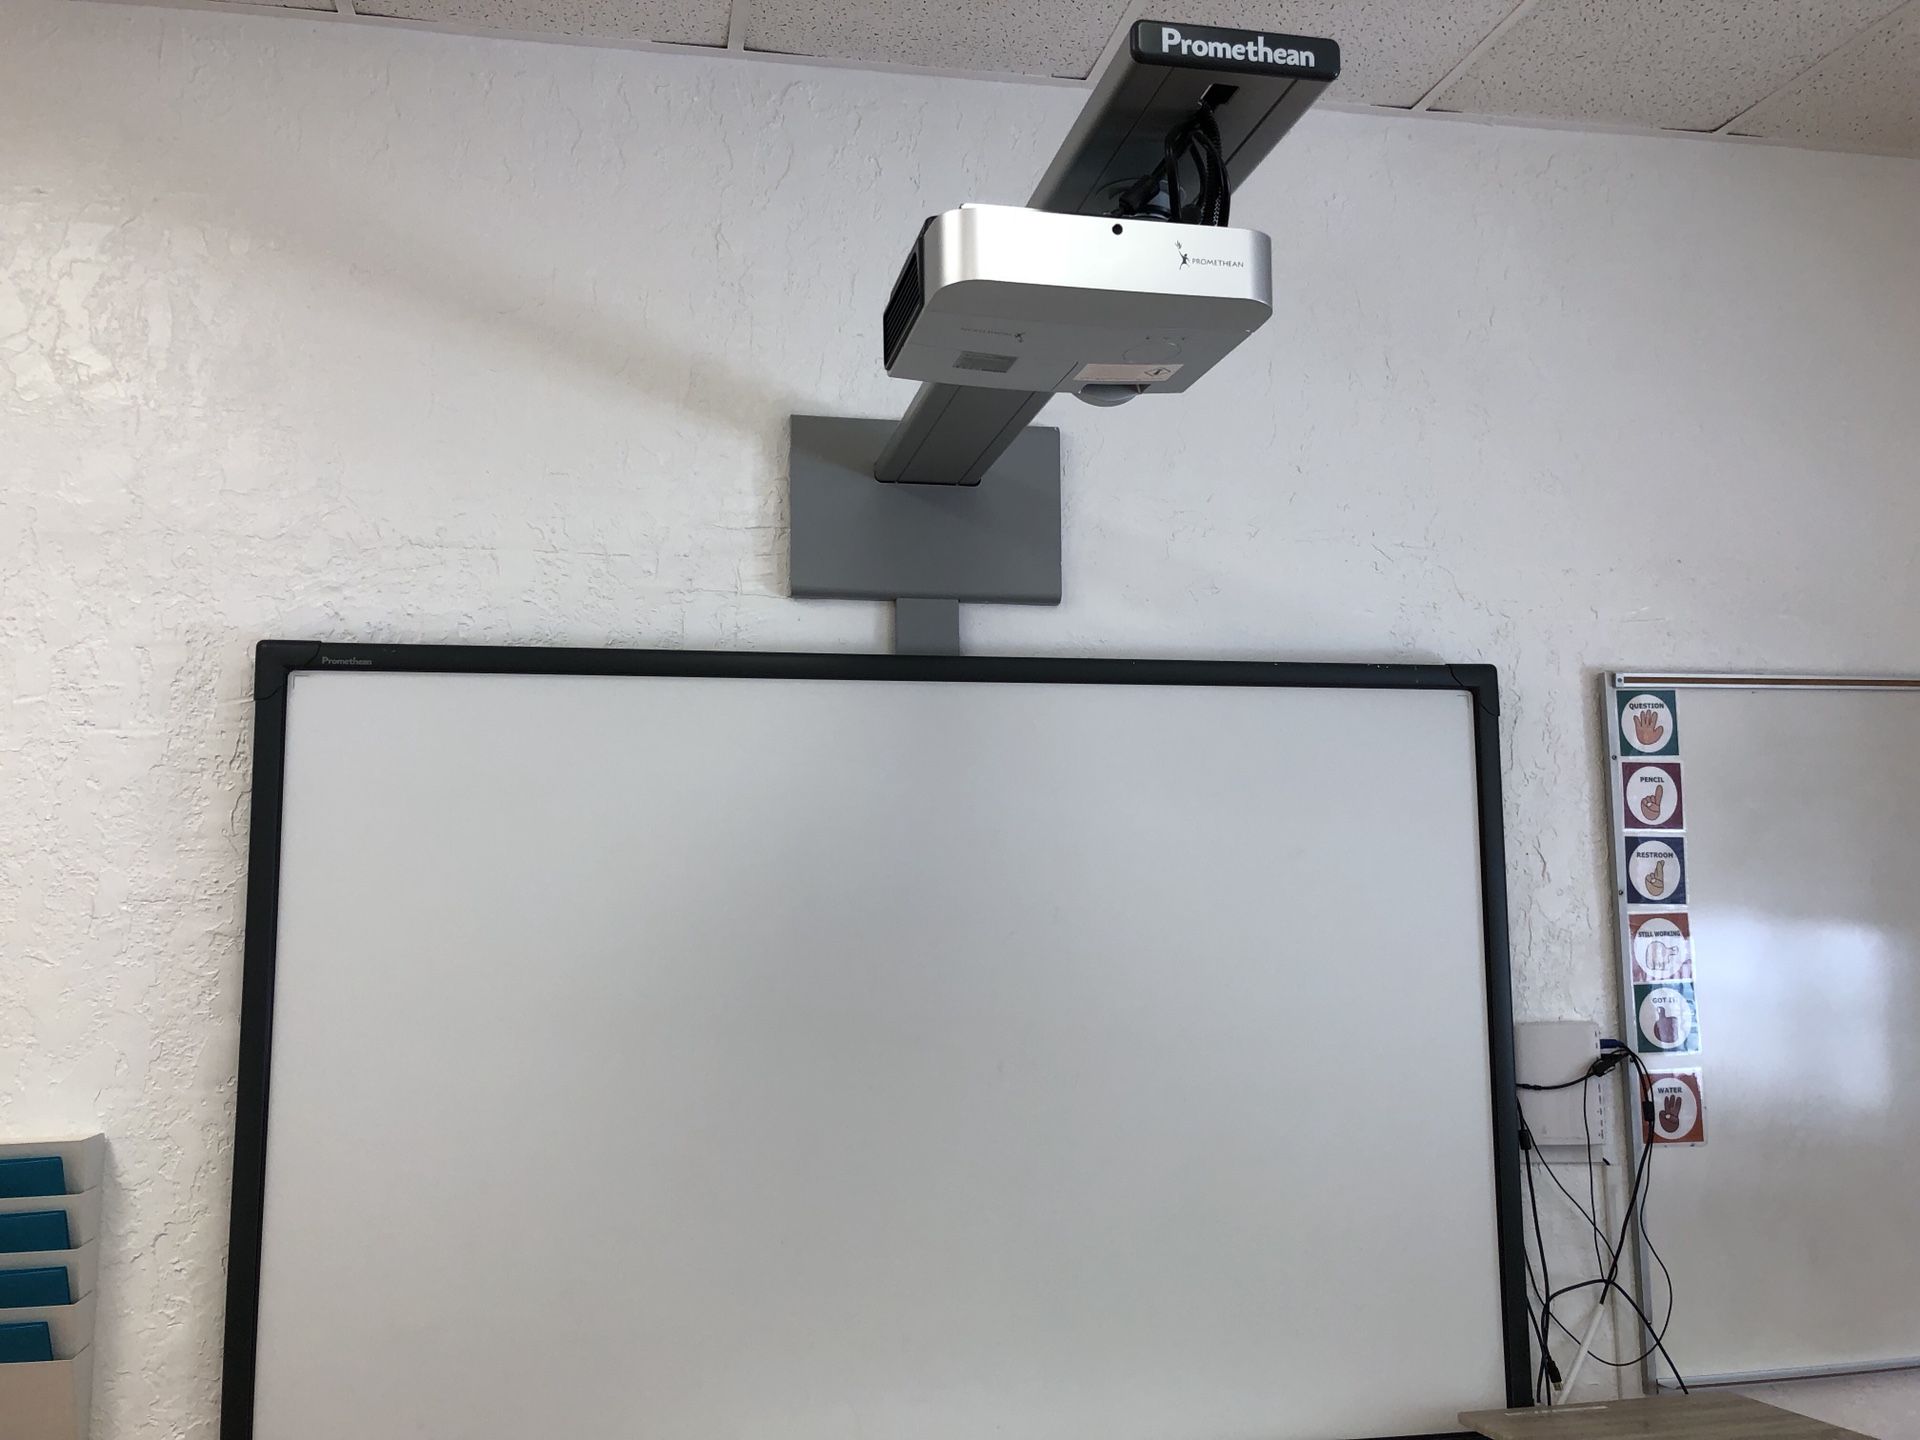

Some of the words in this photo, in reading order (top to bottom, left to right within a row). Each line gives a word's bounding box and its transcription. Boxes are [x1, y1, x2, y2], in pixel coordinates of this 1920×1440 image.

[1161, 27, 1315, 67] Promethean
[1192, 258, 1244, 267] PROMETHEAN
[321, 656, 372, 665] Promethean
[1629, 702, 1664, 710] QUESTION
